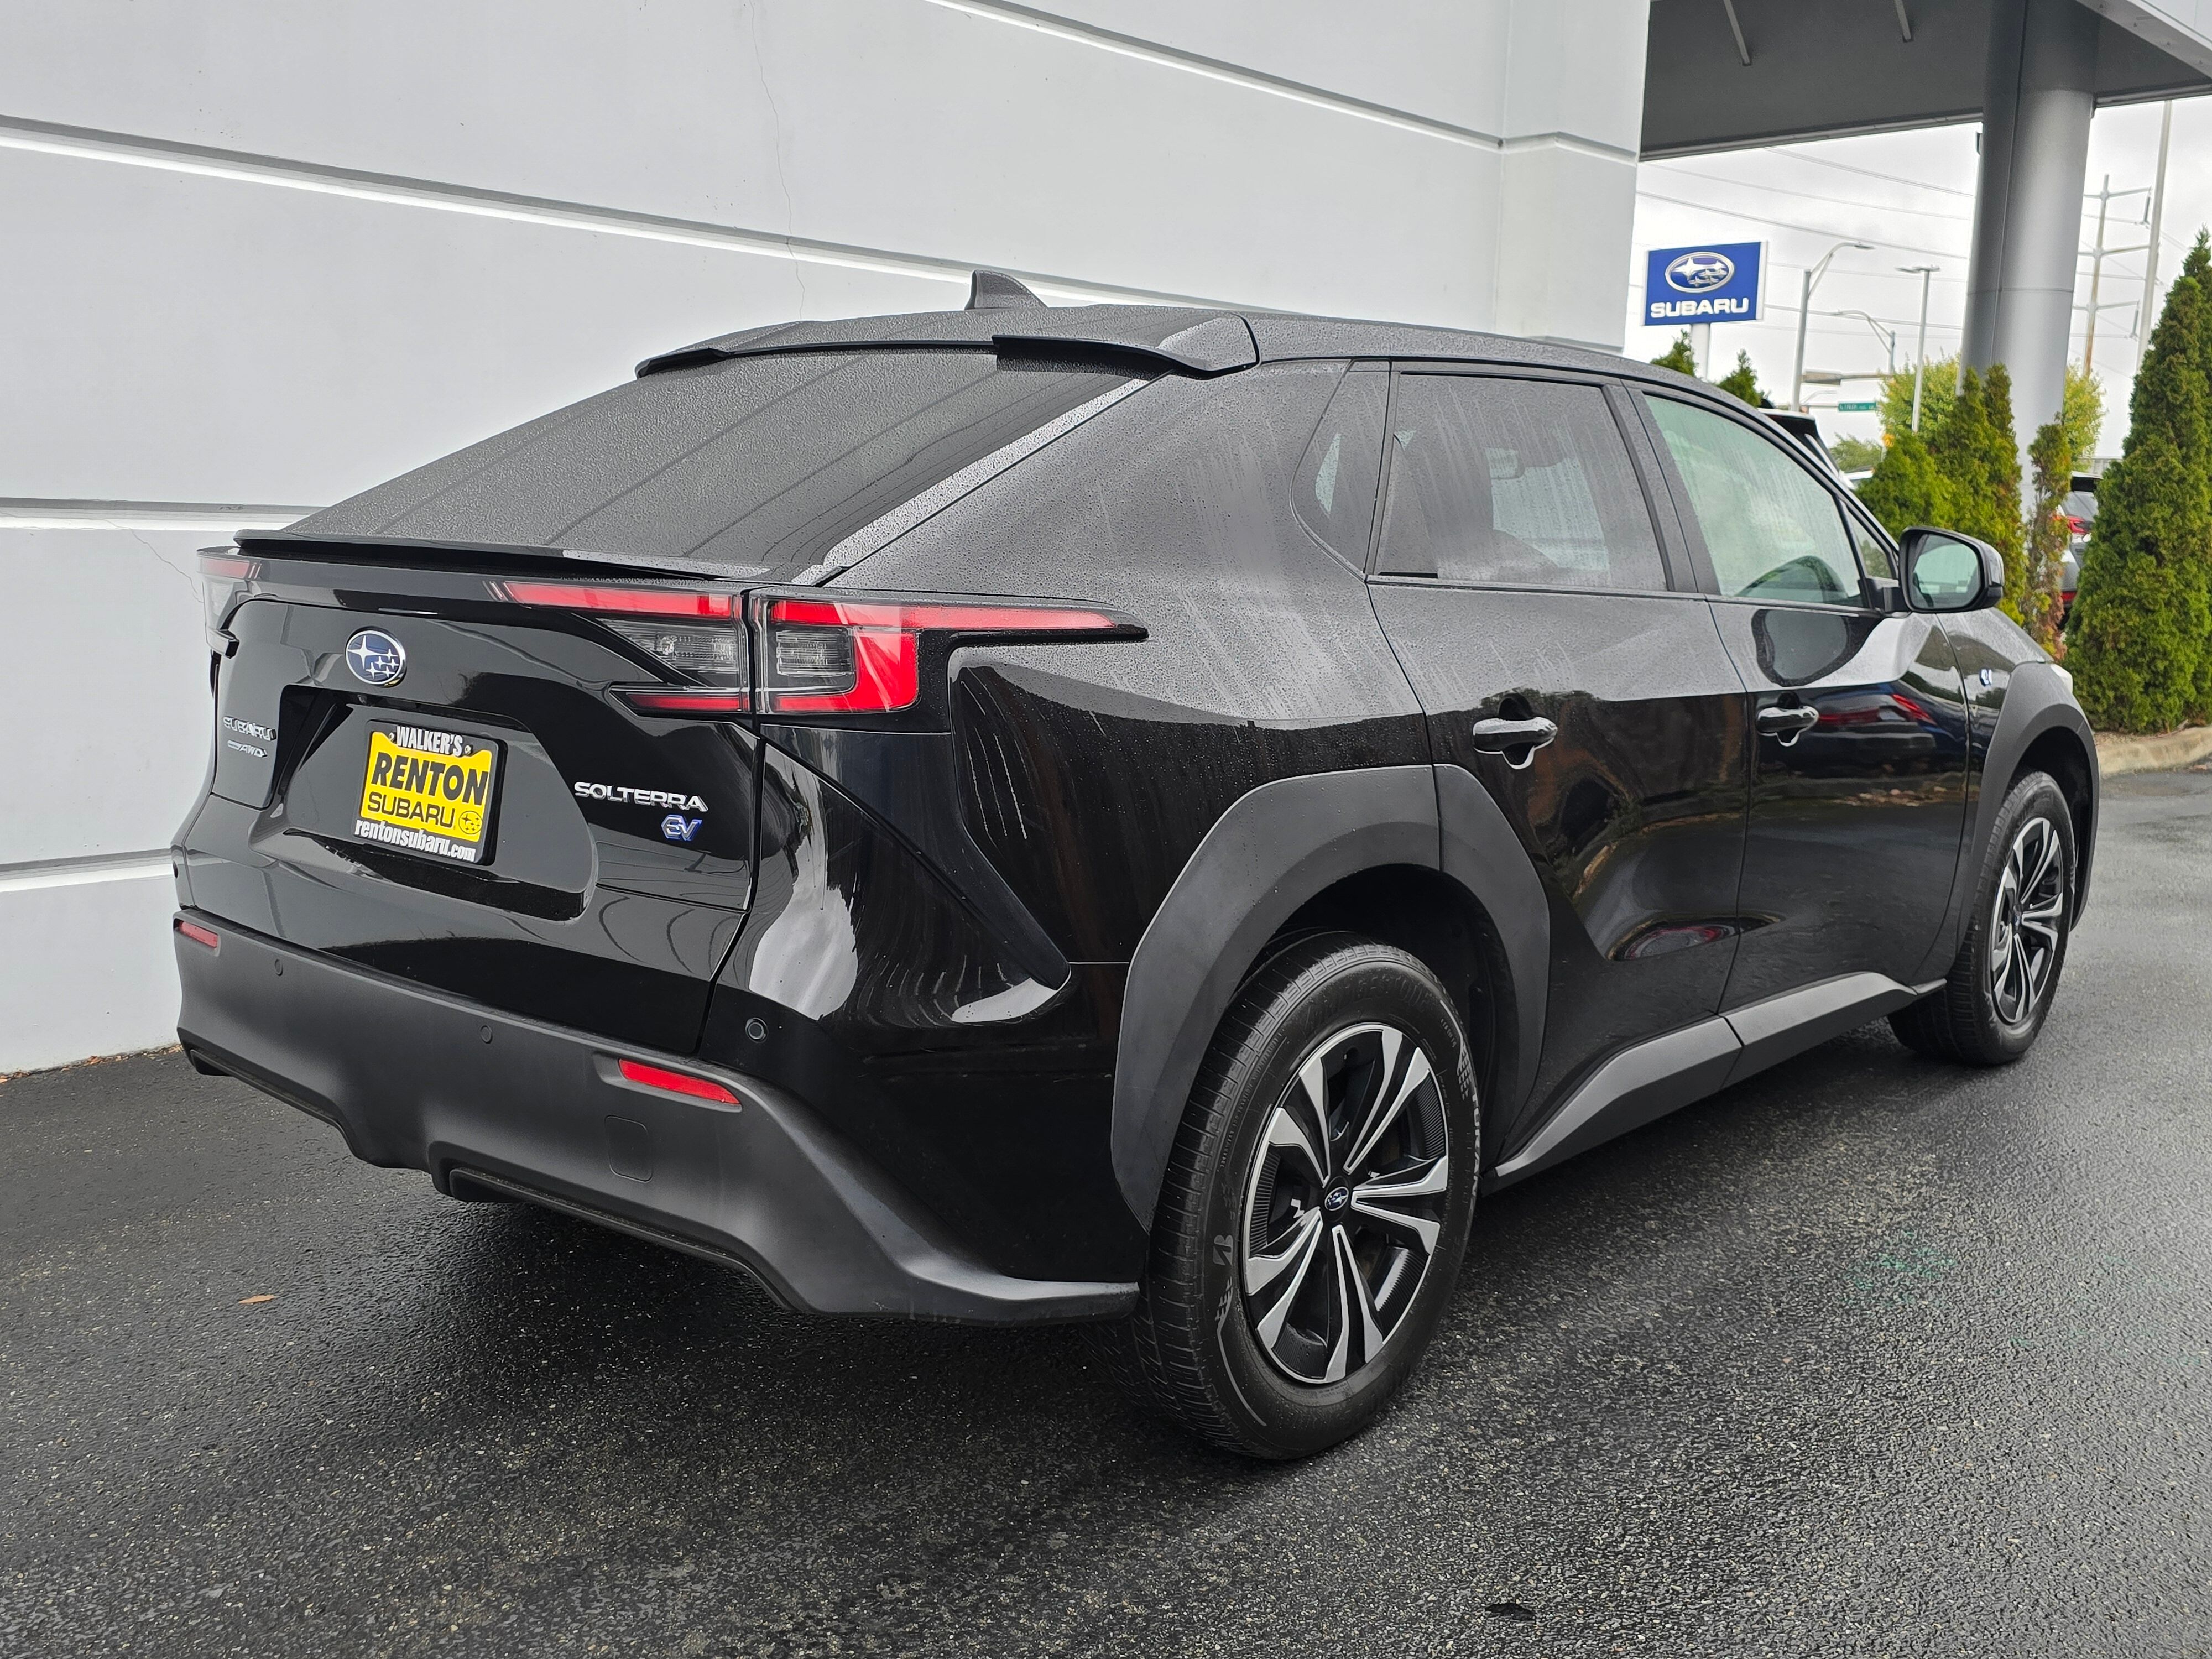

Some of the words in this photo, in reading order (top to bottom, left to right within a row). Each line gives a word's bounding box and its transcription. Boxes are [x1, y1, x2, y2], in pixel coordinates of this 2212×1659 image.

[1651, 298, 1749, 318] SUBARU
[223, 716, 276, 741] SUBARU
[397, 726, 463, 757] WALKER'S
[238, 744, 268, 758] AWD
[371, 751, 489, 806] RENTON
[367, 791, 455, 828] SUBARU
[574, 781, 709, 812] SOLTERRA
[354, 819, 476, 862] rentonsubaru.com
[661, 814, 702, 841] EV
